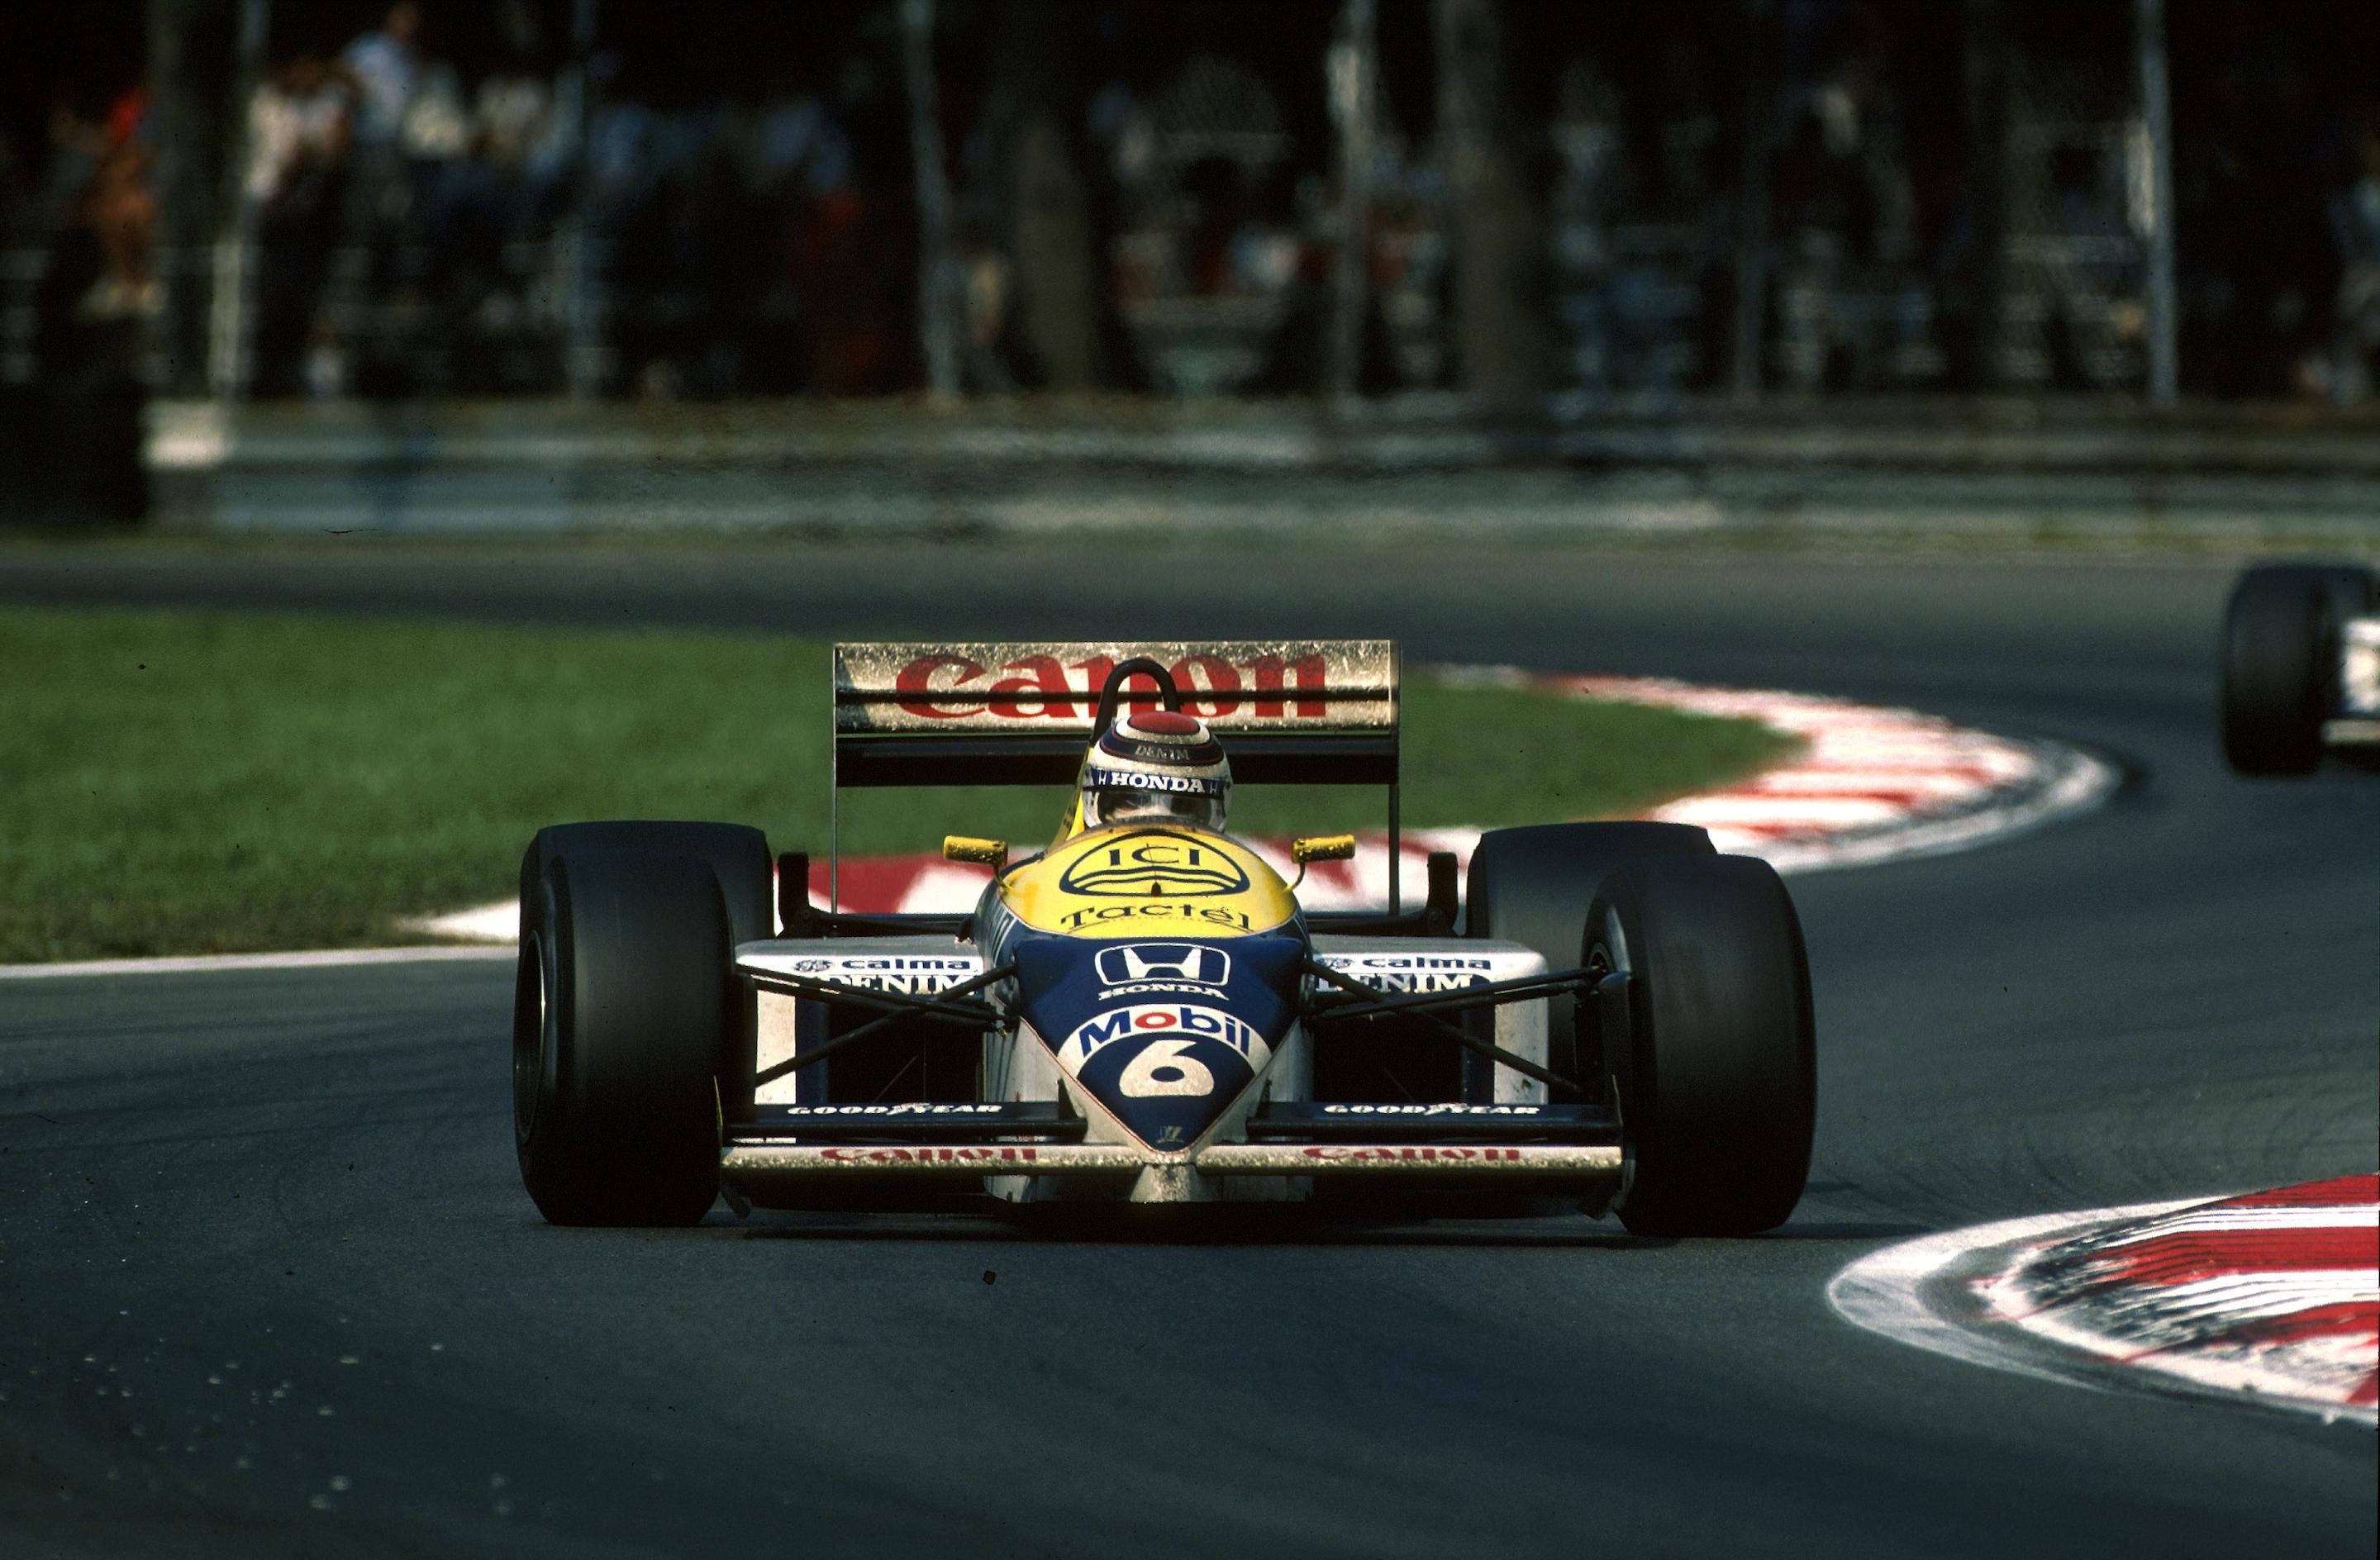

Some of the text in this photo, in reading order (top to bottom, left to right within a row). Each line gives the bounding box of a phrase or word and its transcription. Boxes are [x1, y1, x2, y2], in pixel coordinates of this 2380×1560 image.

[895, 654, 1327, 718] Canon
[1135, 744, 1190, 761] DENIM
[1110, 772, 1206, 793] HONDA
[1108, 845, 1200, 866] ICI
[1060, 903, 1252, 931] Tactel
[841, 958, 971, 970] calma
[1362, 956, 1492, 971] calma
[1097, 983, 1230, 1001] HONDA
[1077, 1007, 1251, 1057] Mobil
[1118, 1039, 1215, 1098] 6
[787, 1102, 1002, 1115] GOODYEAR
[1324, 1102, 1540, 1115] GOODYEAR
[820, 1147, 1036, 1162] Canon
[1302, 1147, 1521, 1162] Canon
